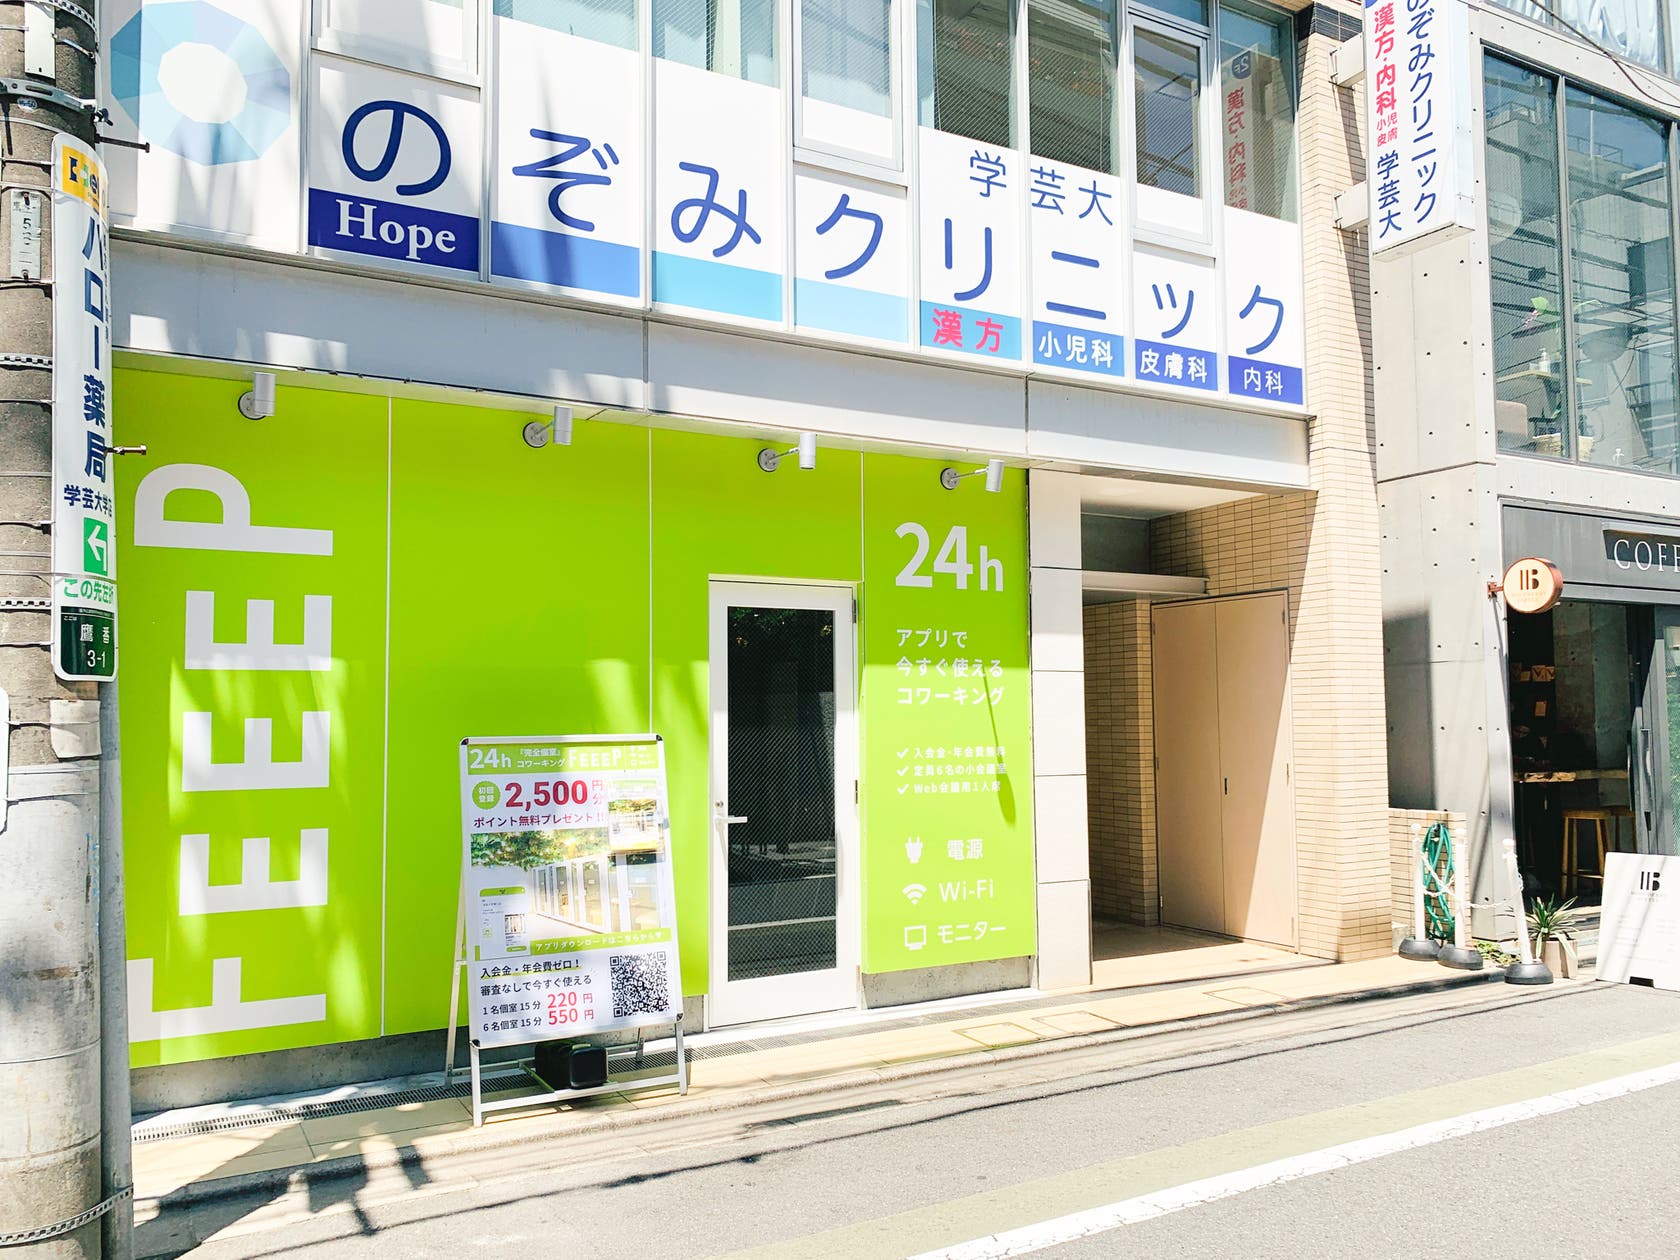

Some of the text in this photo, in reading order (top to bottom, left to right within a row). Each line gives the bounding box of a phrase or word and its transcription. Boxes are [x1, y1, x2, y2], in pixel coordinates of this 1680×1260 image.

[969, 149, 1113, 226] 学芸大
[1377, 150, 1401, 238] 学芸大
[335, 199, 457, 261] Hope
[342, 100, 1285, 355] のぞみクリニック
[932, 308, 1004, 353] 漢方
[1038, 333, 1113, 370] 小児科
[1139, 347, 1208, 385] 皮膚科
[1243, 365, 1283, 397] 内科
[895, 522, 1004, 592] 24h
[896, 628, 968, 649] アプリで
[87, 649, 106, 669] 3-1
[896, 656, 1004, 678] 今すぐ使える
[897, 685, 1005, 706] コワーキング
[126, 463, 333, 1043] FEEEP
[469, 748, 512, 769] 24h
[516, 758, 565, 768] コワーキング
[505, 779, 588, 812] 2,500
[947, 838, 984, 860] 電源
[938, 879, 994, 902] Wi-Fi
[937, 920, 1007, 943] モニター
[480, 974, 592, 997] 審査なしで今すぐ使える
[547, 991, 577, 1009] 220
[548, 1008, 578, 1026] 550
